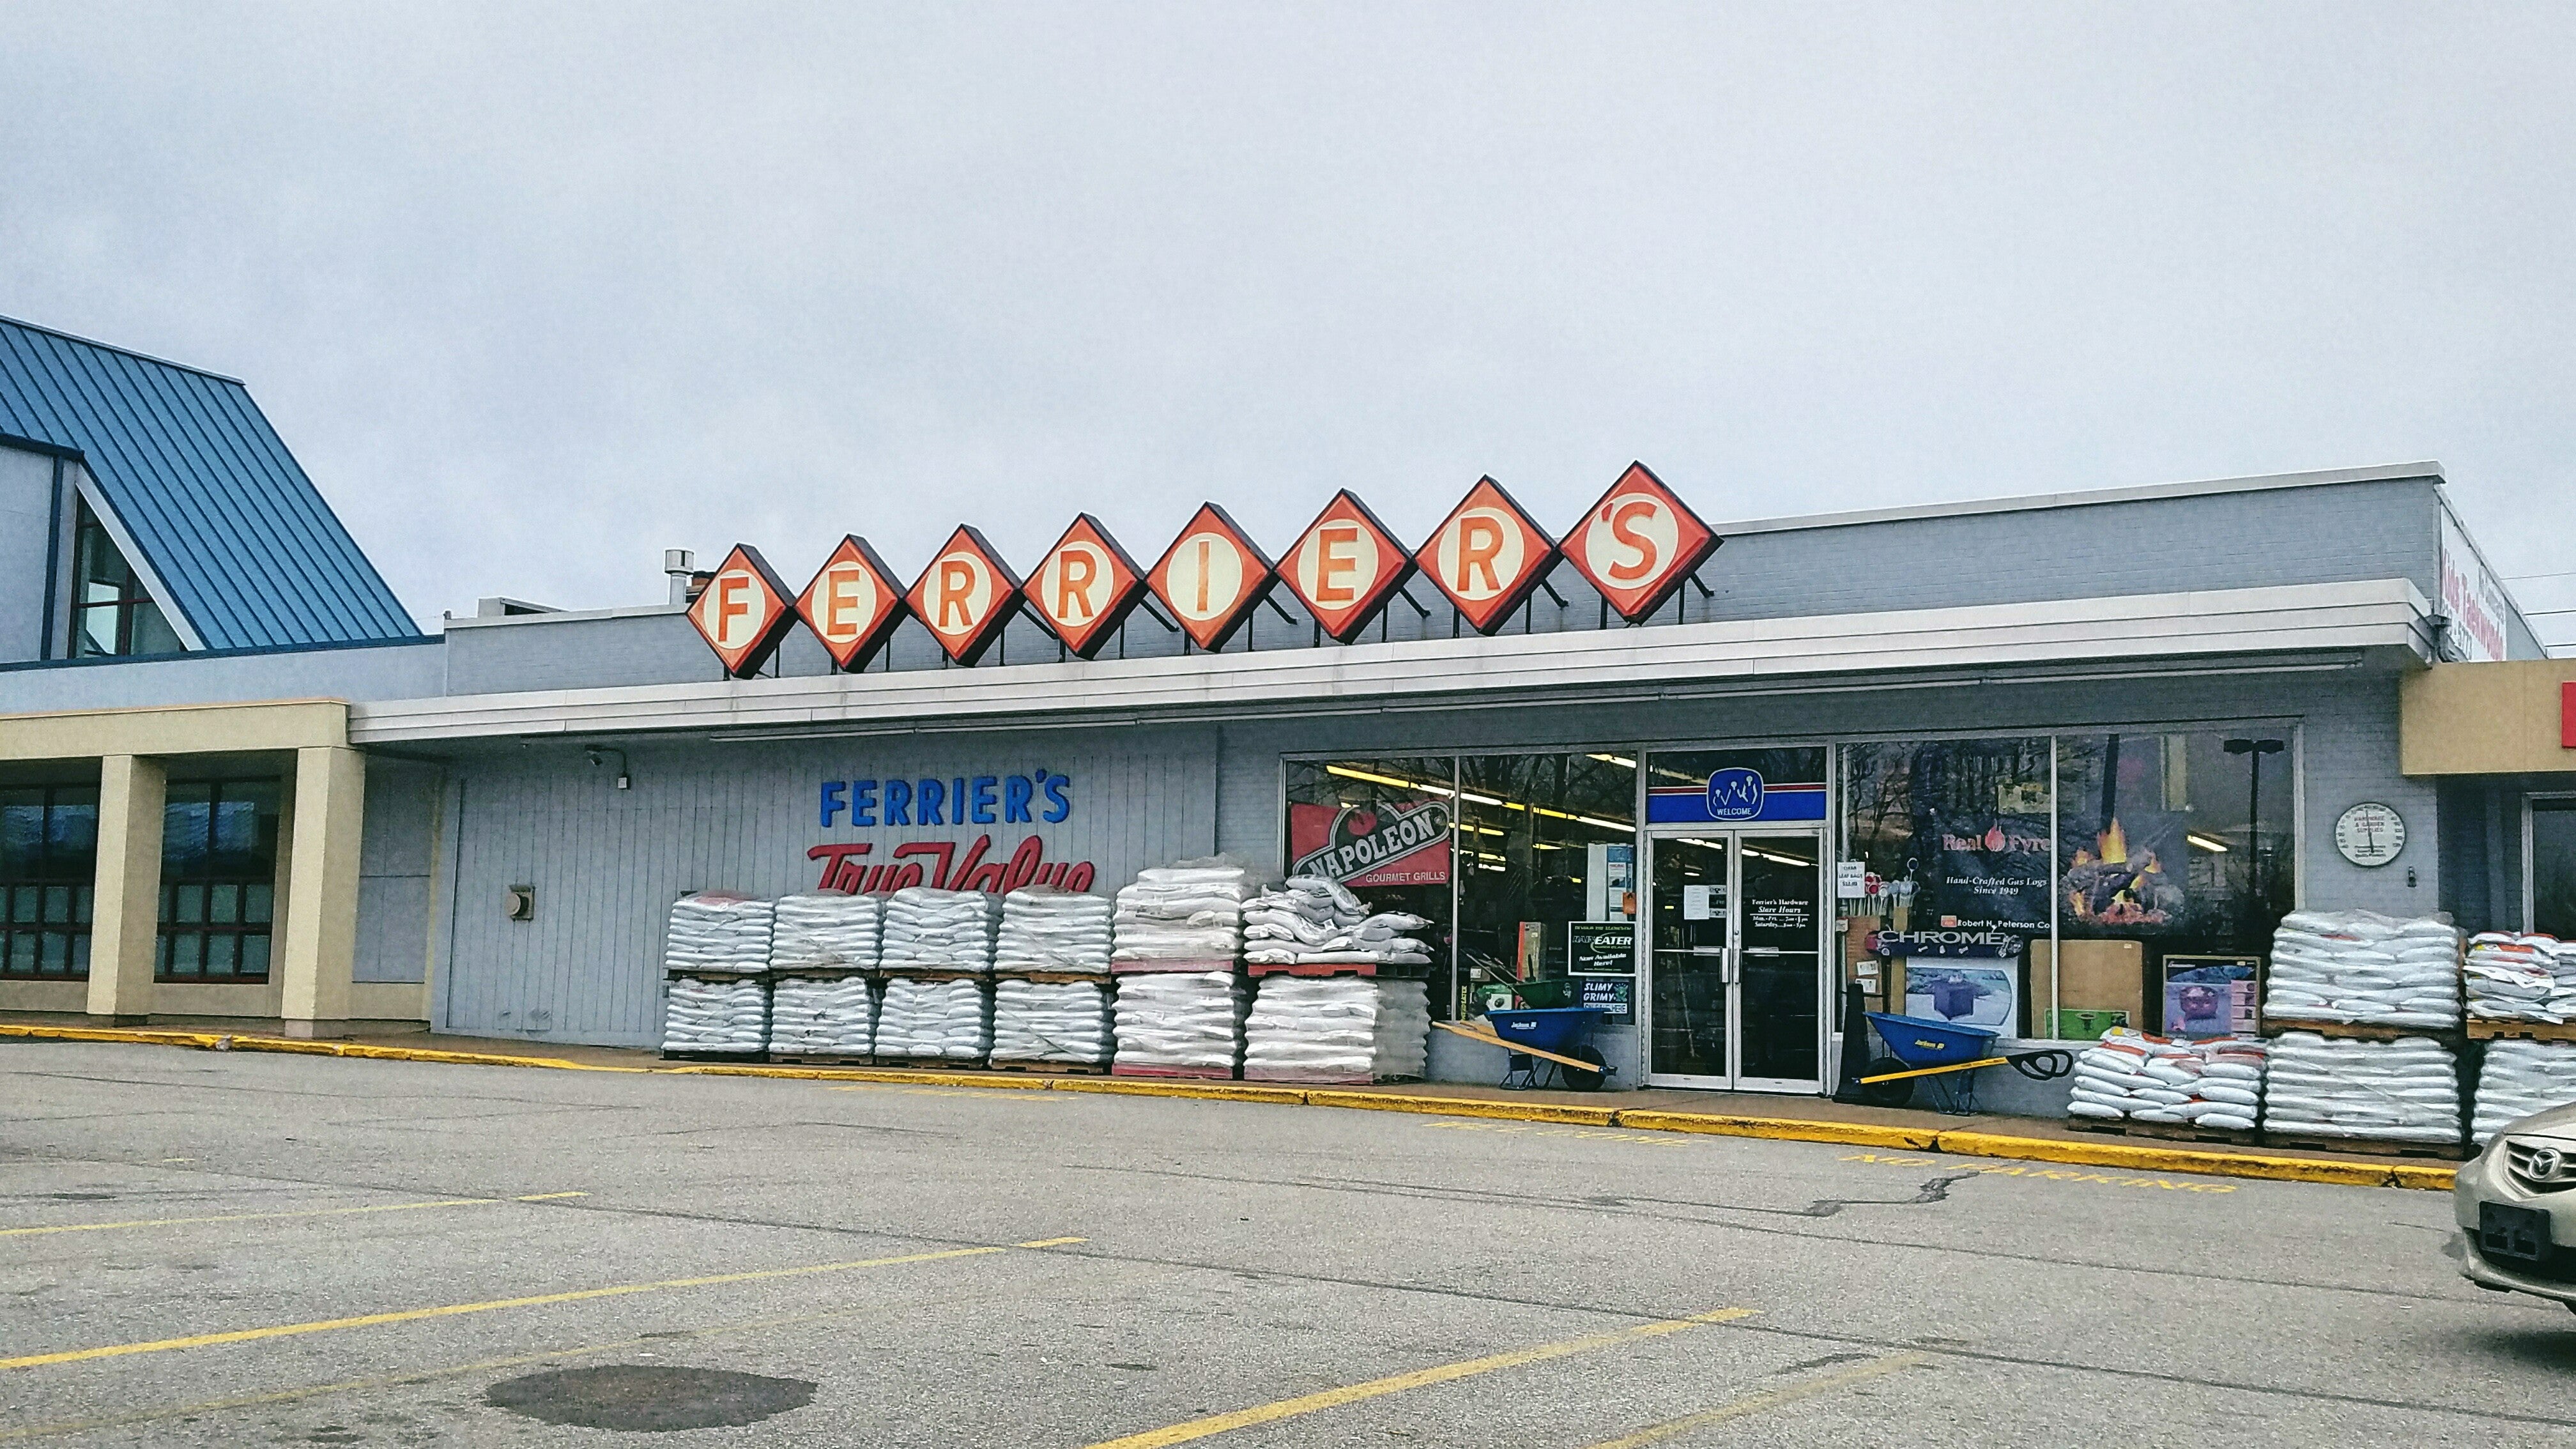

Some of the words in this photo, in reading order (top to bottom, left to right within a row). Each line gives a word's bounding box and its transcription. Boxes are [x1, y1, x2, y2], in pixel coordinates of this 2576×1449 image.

[718, 501, 1659, 642] FERRIER'S
[820, 768, 1071, 828] FERRIER'S
[1308, 811, 1436, 878] NAPOLEON
[1942, 833, 1983, 851] Real
[2004, 834, 2051, 857] Fyre
[1365, 873, 1411, 883] GOURMET
[1413, 871, 1446, 881] GRILLS
[1946, 876, 2005, 886] Hand-Crafted
[2007, 877, 2024, 885] Gas
[2027, 877, 2048, 887] Logs
[1973, 886, 1997, 894] Since
[1878, 930, 2005, 946] CHROME
[1584, 983, 1613, 991] SLIMY
[1945, 1163, 2237, 1193] PARKING
